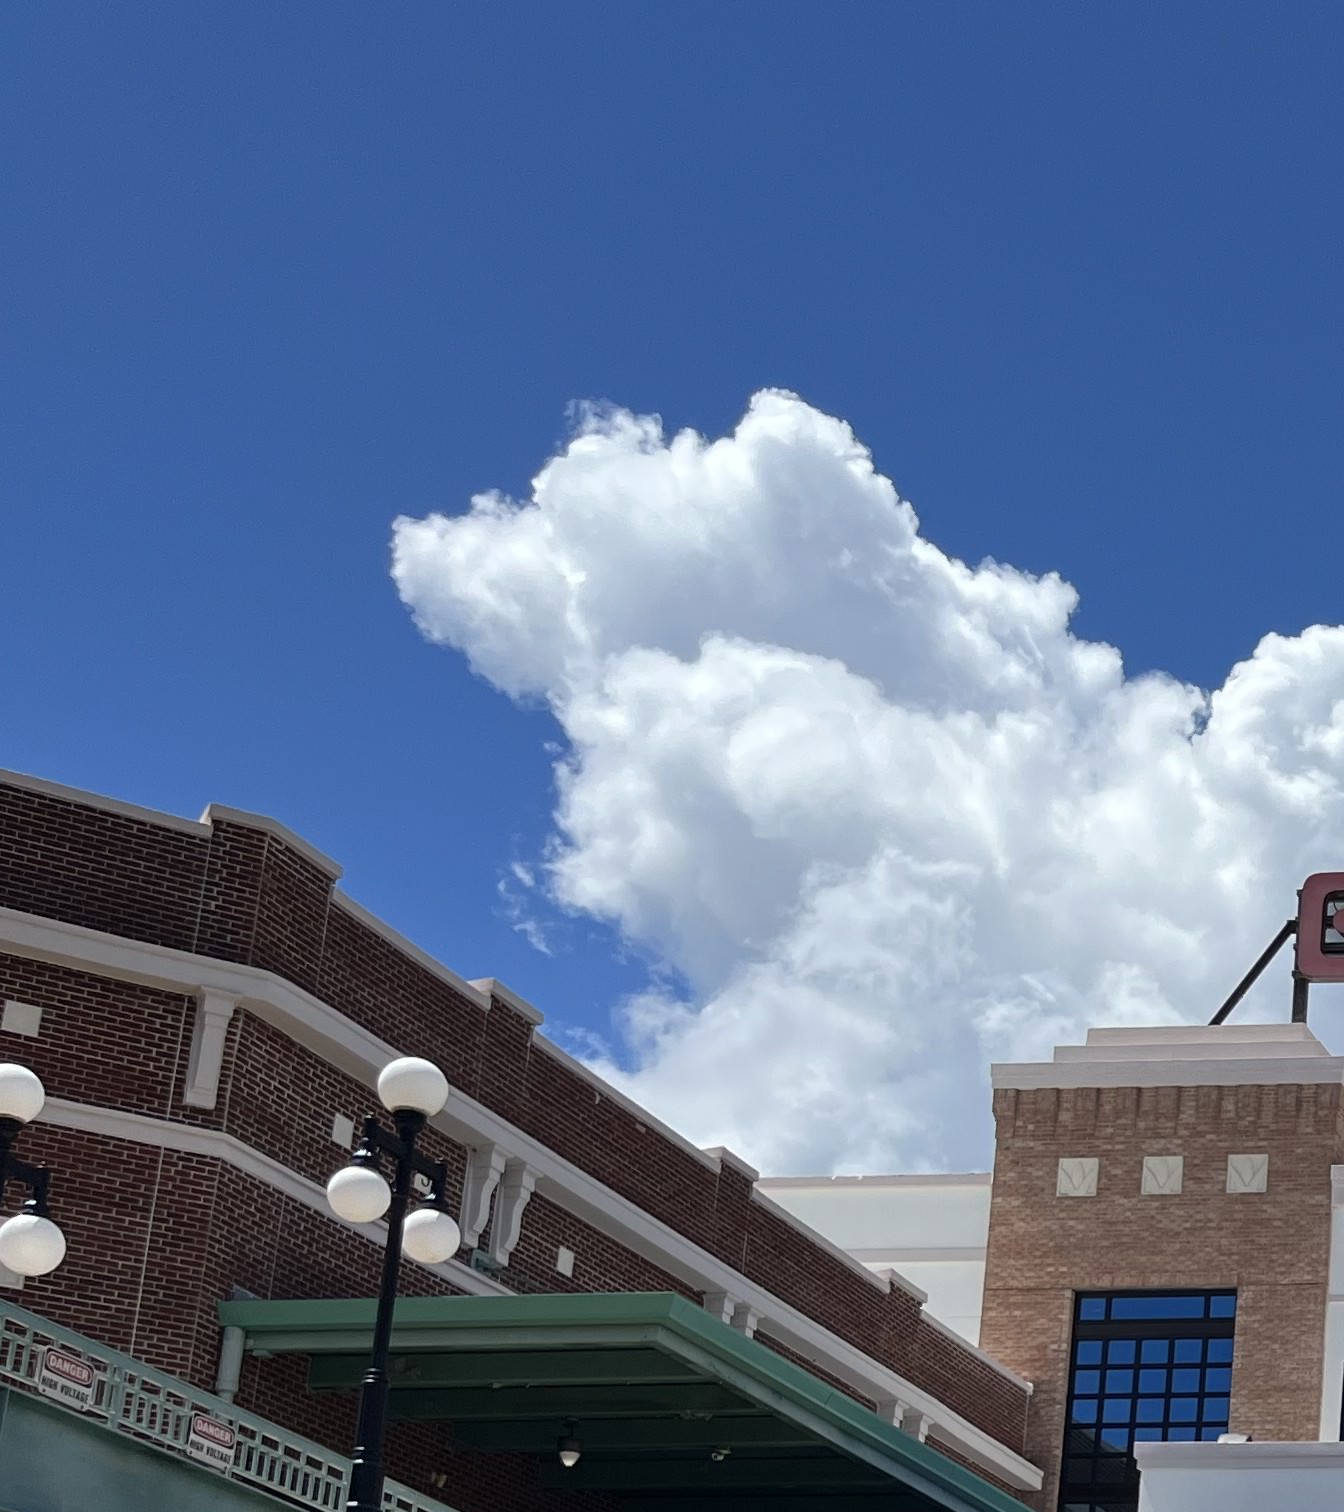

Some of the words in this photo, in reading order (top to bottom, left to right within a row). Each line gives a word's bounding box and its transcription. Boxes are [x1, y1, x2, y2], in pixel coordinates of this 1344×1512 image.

[49, 1355, 89, 1382] DANGER
[41, 1375, 58, 1391] HIGH
[60, 1383, 90, 1405] VOLTAGE
[197, 1419, 231, 1443] DANGER
